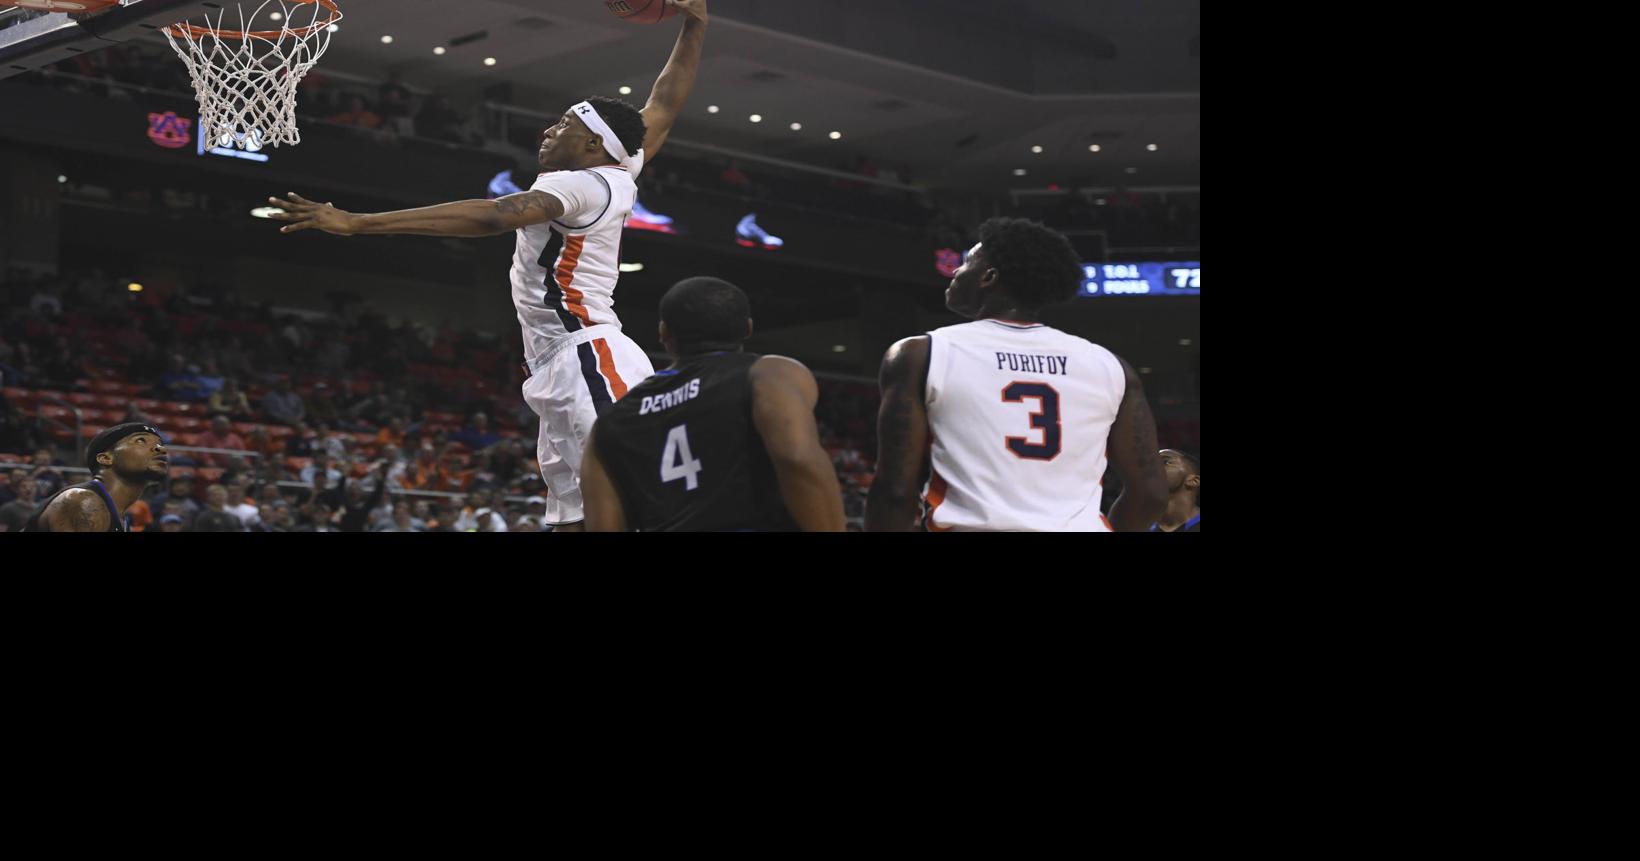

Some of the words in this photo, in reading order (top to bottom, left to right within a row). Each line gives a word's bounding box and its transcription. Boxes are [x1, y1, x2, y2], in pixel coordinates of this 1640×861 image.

[1171, 268, 1200, 288] 72
[995, 352, 1067, 375] PURIFOY
[638, 378, 700, 415] DENNIS
[1001, 380, 1062, 461] 3
[660, 423, 703, 491] 4
